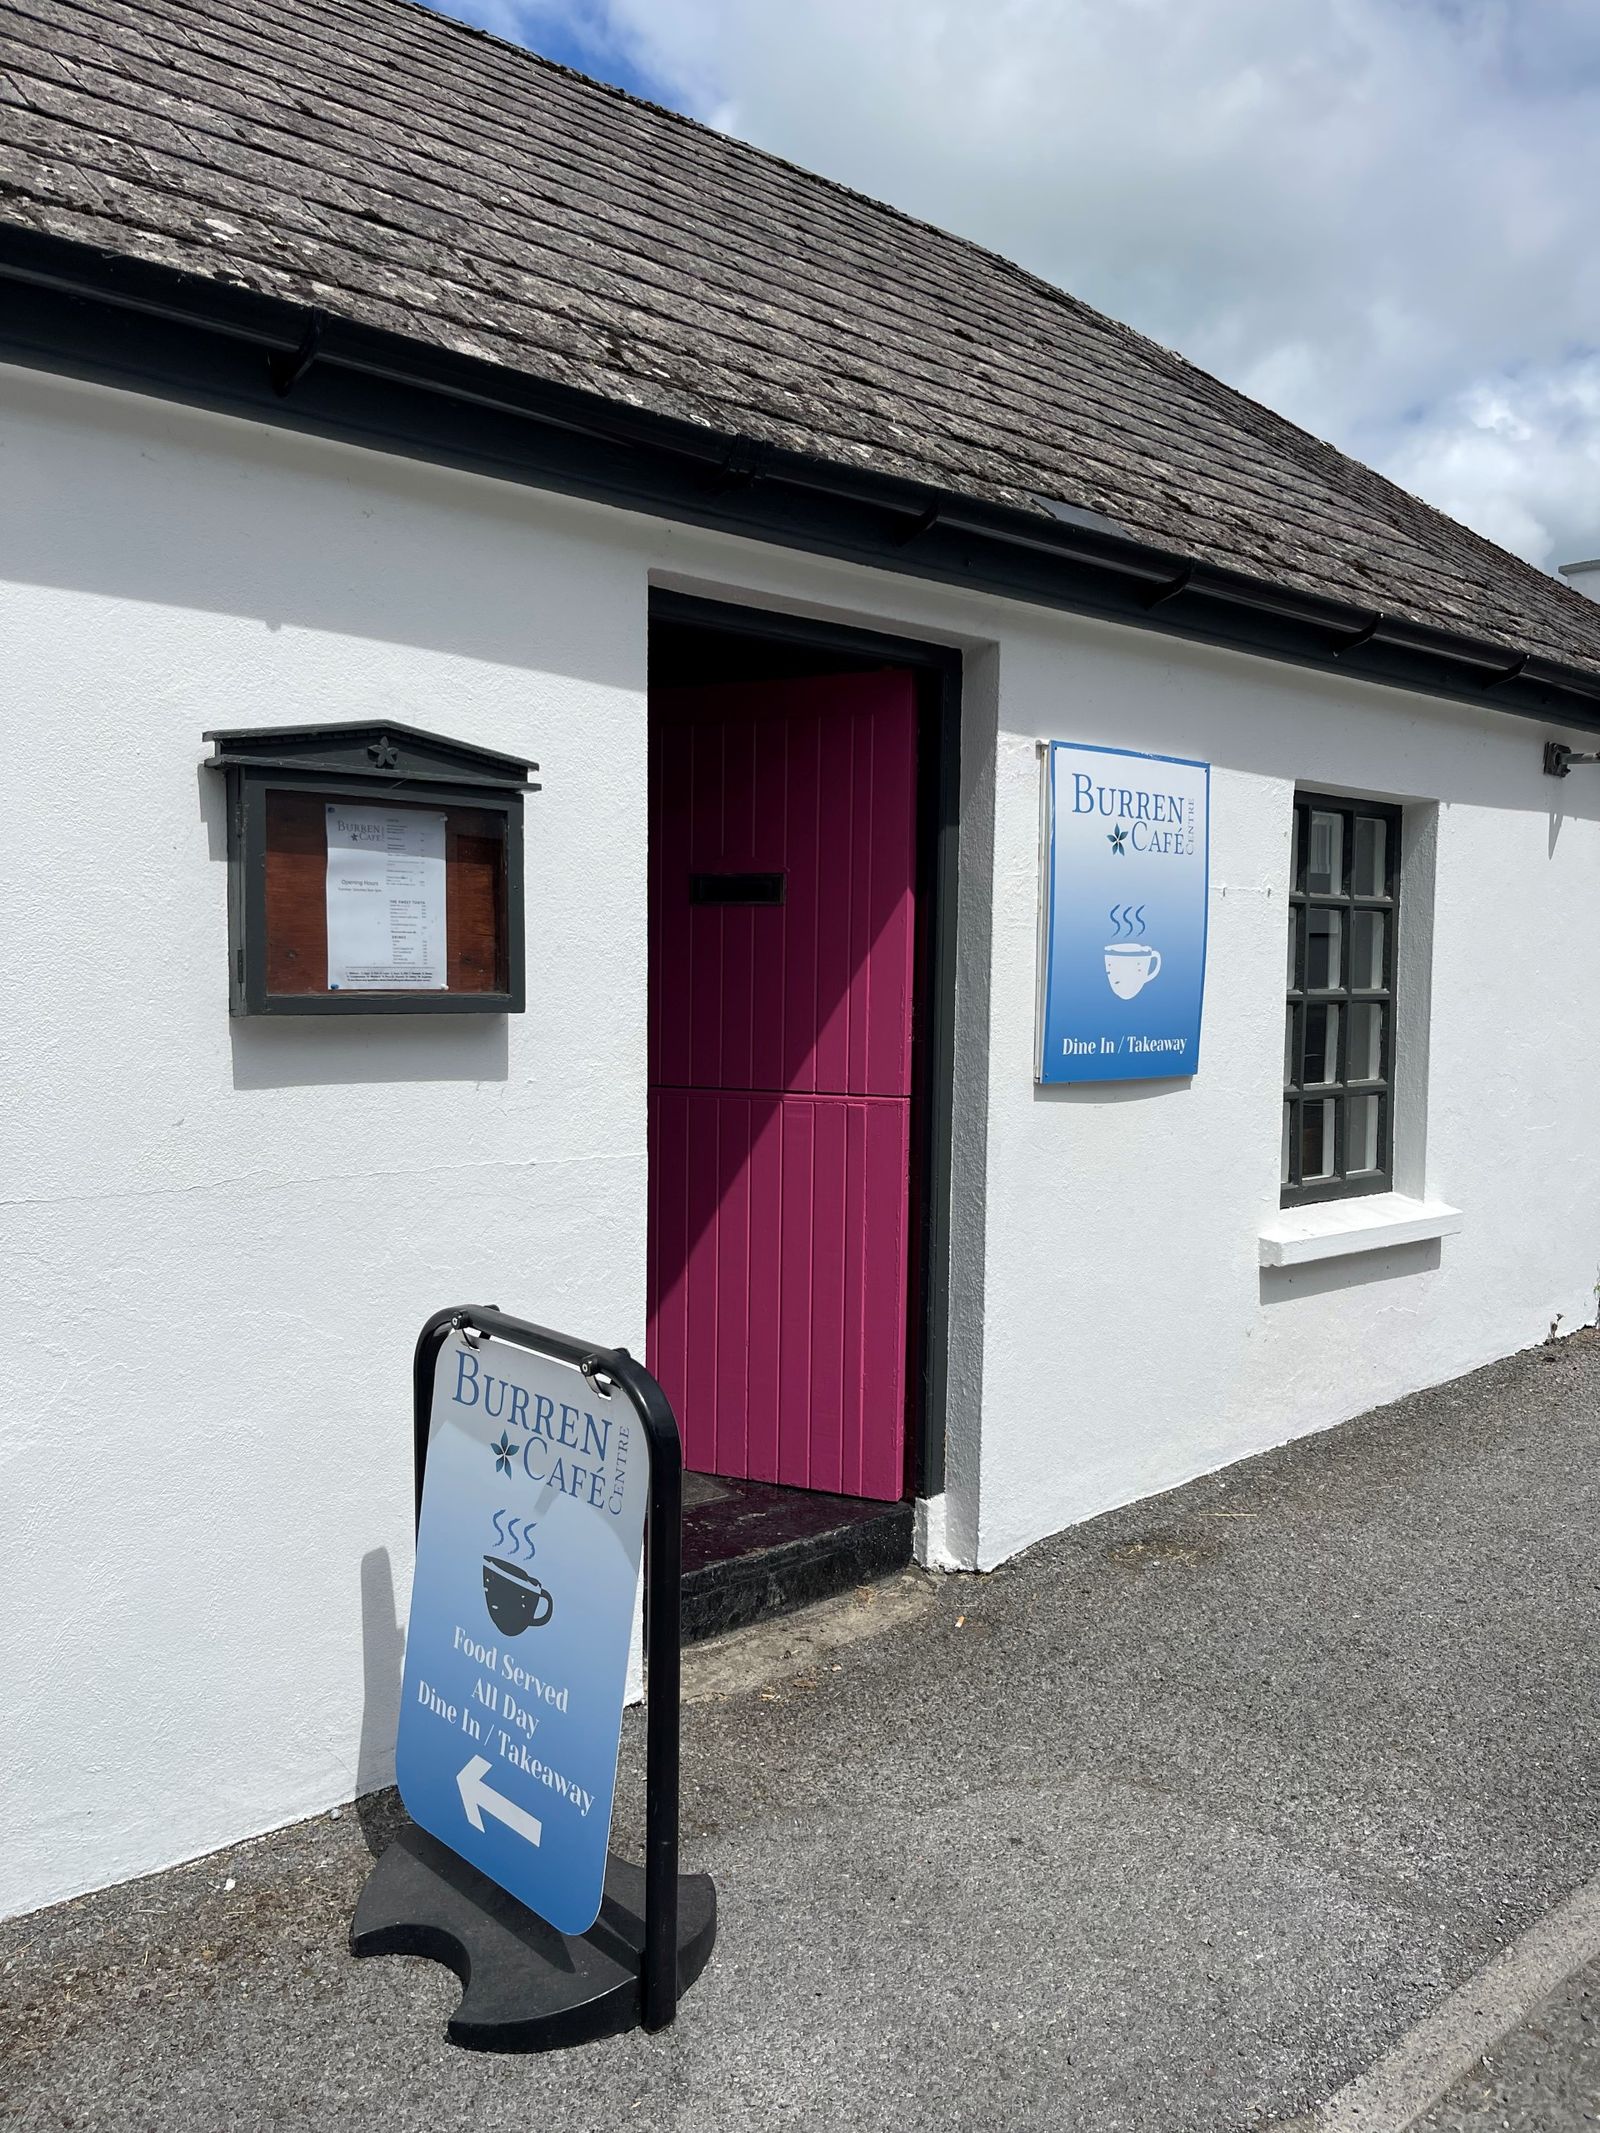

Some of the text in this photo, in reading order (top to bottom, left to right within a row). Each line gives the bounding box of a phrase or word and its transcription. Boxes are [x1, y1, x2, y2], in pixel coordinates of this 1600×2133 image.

[337, 820, 380, 834] BURREN
[1071, 773, 1185, 825] BURREN
[1186, 798, 1195, 856] CENTRE
[1131, 821, 1185, 855] CAFÉ
[1062, 1035, 1188, 1056] Dine In / Takeaway
[452, 1349, 612, 1462] BURREN
[523, 1436, 606, 1509] CAFÉ
[608, 1425, 630, 1515] CENTRE
[453, 1625, 569, 1714] Food Served
[471, 1677, 540, 1740] All Day
[417, 1679, 596, 1817] Dine In / Takeaway
